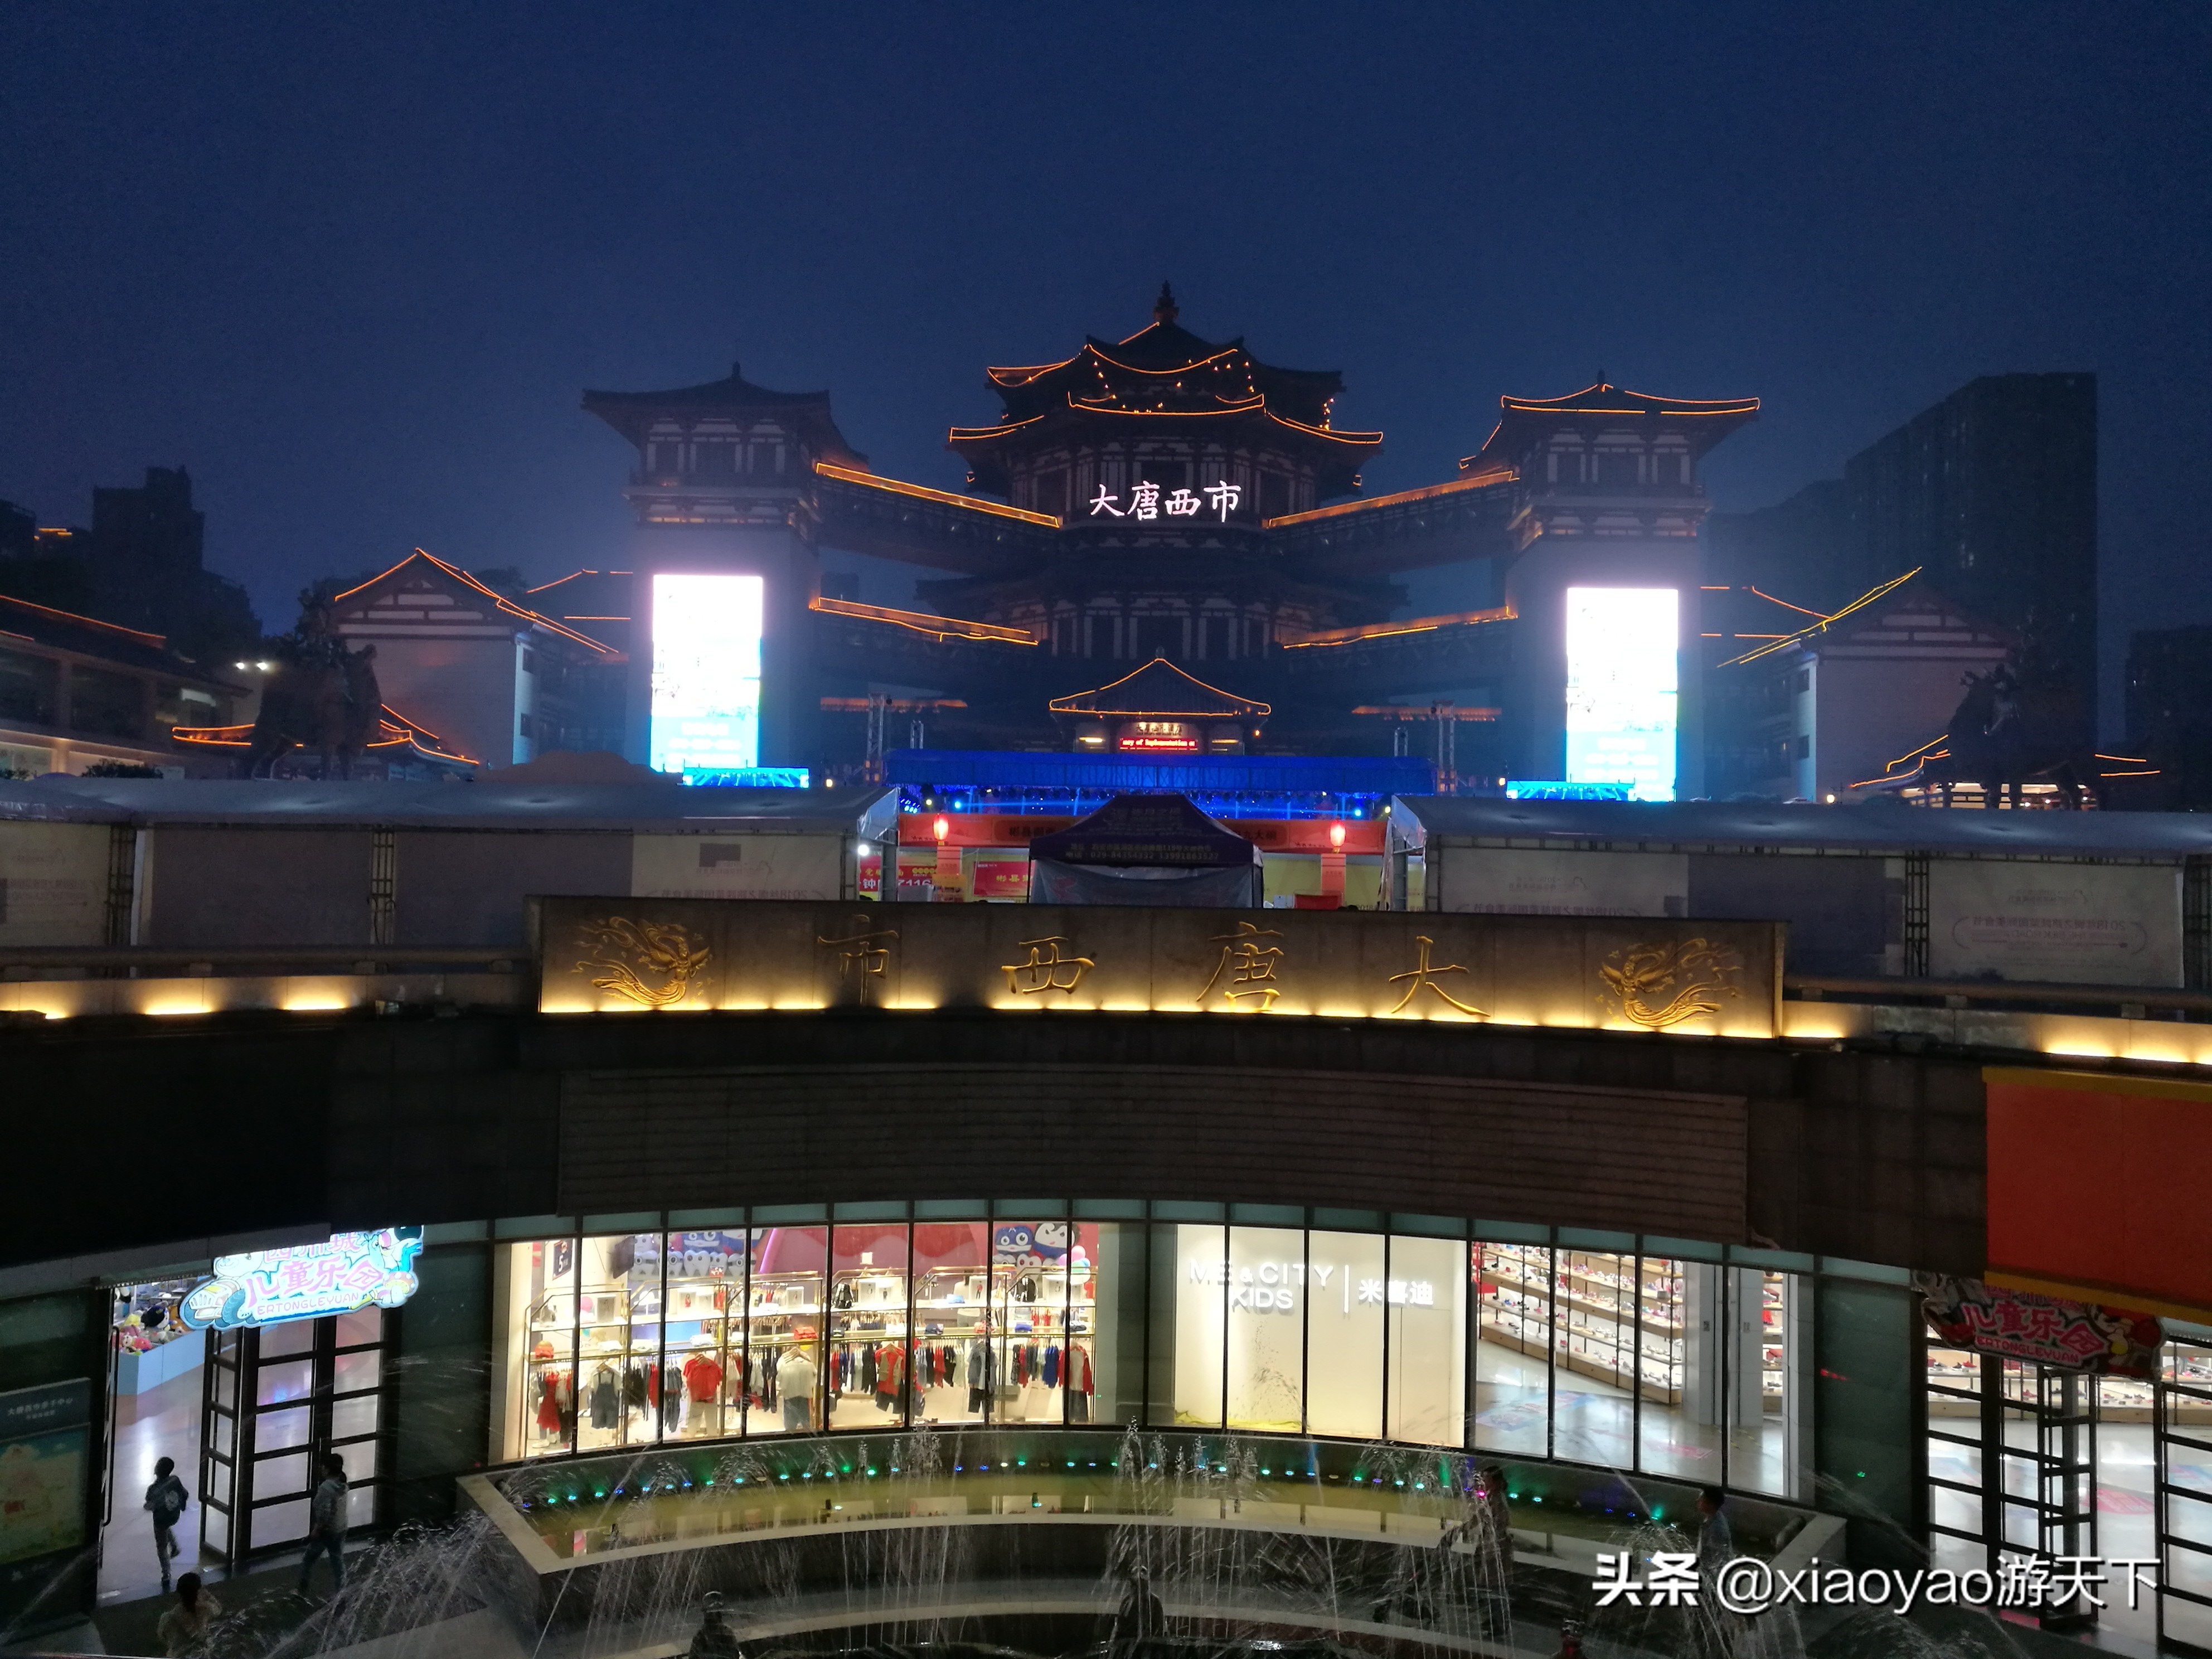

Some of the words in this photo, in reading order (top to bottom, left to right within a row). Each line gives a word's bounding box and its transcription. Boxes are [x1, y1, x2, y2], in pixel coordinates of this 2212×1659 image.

[1090, 480, 1241, 522] 大唐西市
[246, 1255, 384, 1308] 儿童乐园
[1259, 1261, 1333, 1287] CITY
[257, 1292, 359, 1316] ERTONGLEYUAN
[1231, 1287, 1294, 1309] KIDS
[1961, 1301, 2105, 1356] 儿童乐园
[1977, 1336, 2079, 1362] ERTONGLEYUAN
